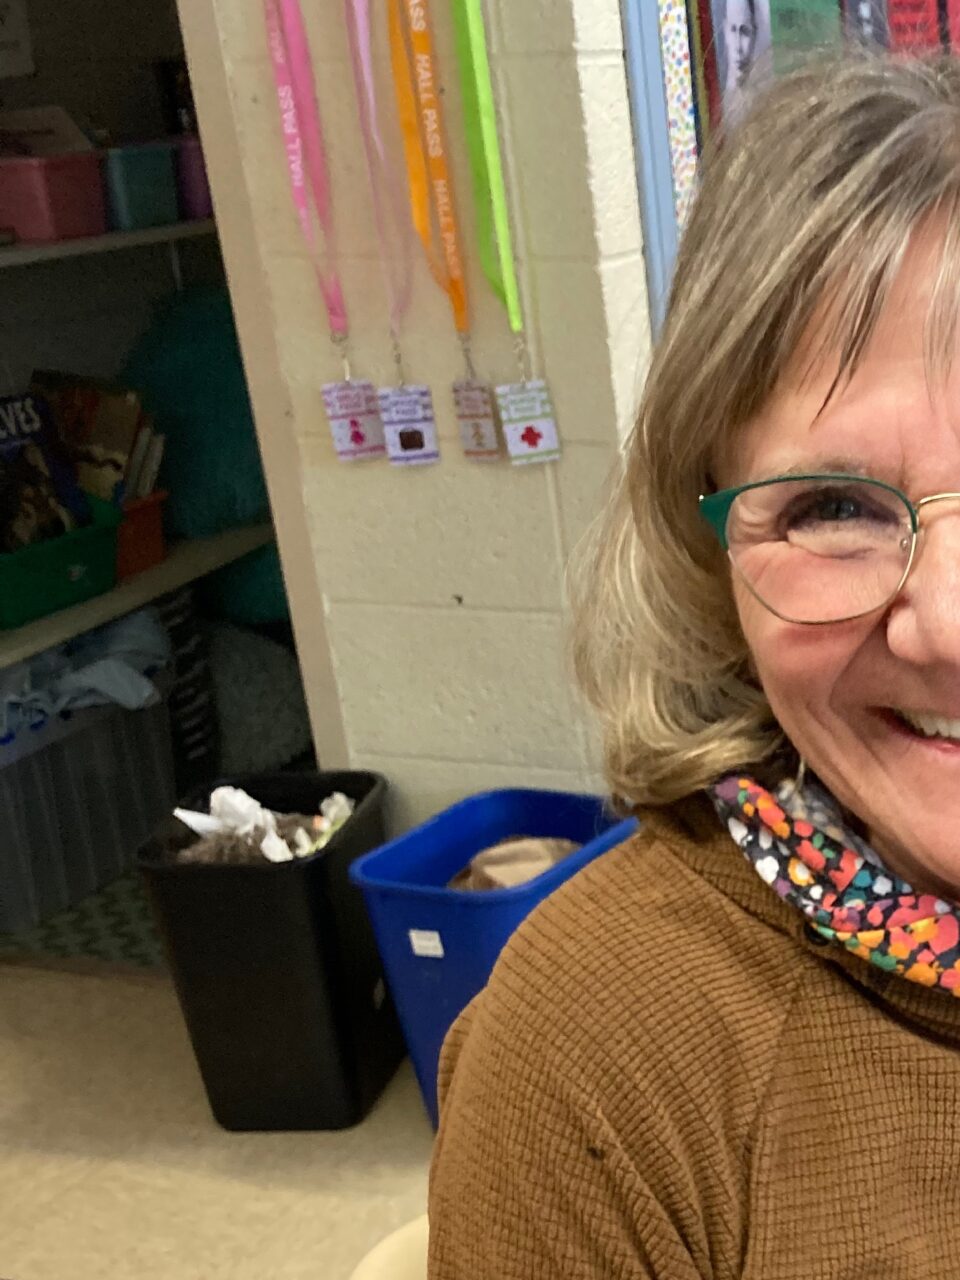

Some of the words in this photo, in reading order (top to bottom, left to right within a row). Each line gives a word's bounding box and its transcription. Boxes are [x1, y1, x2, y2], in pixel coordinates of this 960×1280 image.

[416, 54, 434, 103] HALL
[279, 85, 299, 134] PASS
[423, 108, 443, 158] PASS
[288, 137, 304, 187] HALL
[434, 179, 453, 228] HALL
